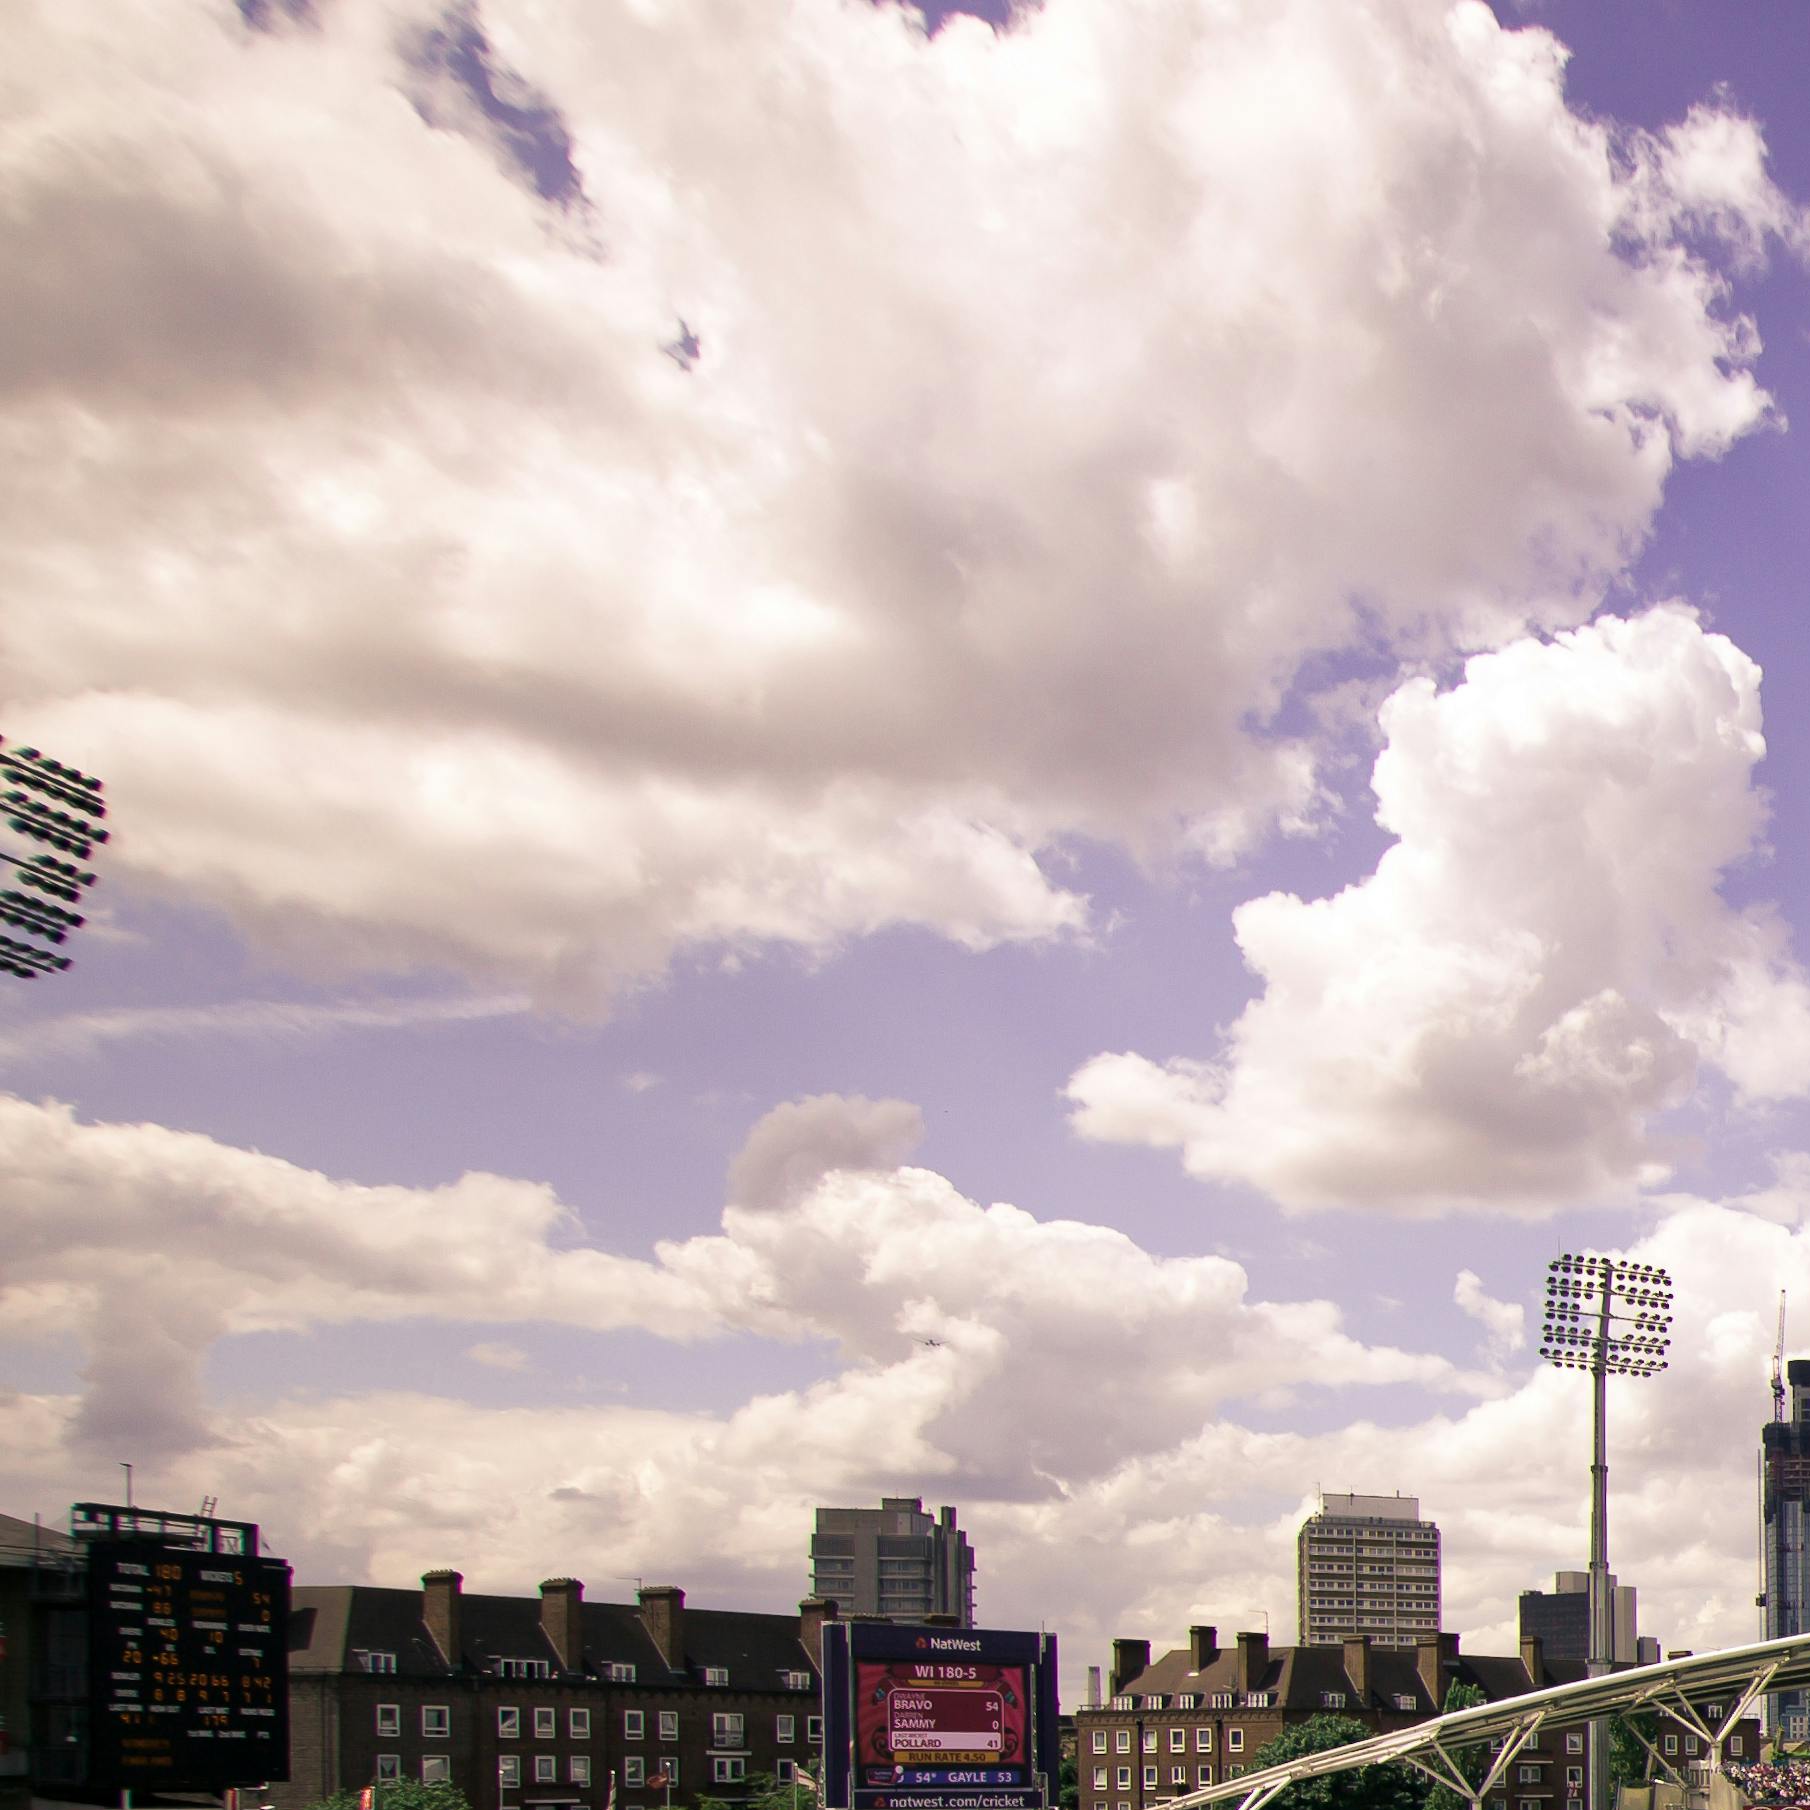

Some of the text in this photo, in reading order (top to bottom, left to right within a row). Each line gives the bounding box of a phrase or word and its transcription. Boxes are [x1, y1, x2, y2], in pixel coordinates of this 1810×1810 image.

[930, 1637, 982, 1651] NatWest
[914, 1665, 977, 1679] WI 180-5
[893, 1700, 999, 1711] BRAVO 54
[893, 1718, 1000, 1730] SAMMY 0
[894, 1738, 999, 1748] POLLARD 41
[908, 1752, 986, 1762] RUN RATE 4.50
[947, 1771, 987, 1782] GAYLE
[997, 1772, 1012, 1782] 53
[889, 1794, 1025, 1809] natwest.com/cricket
